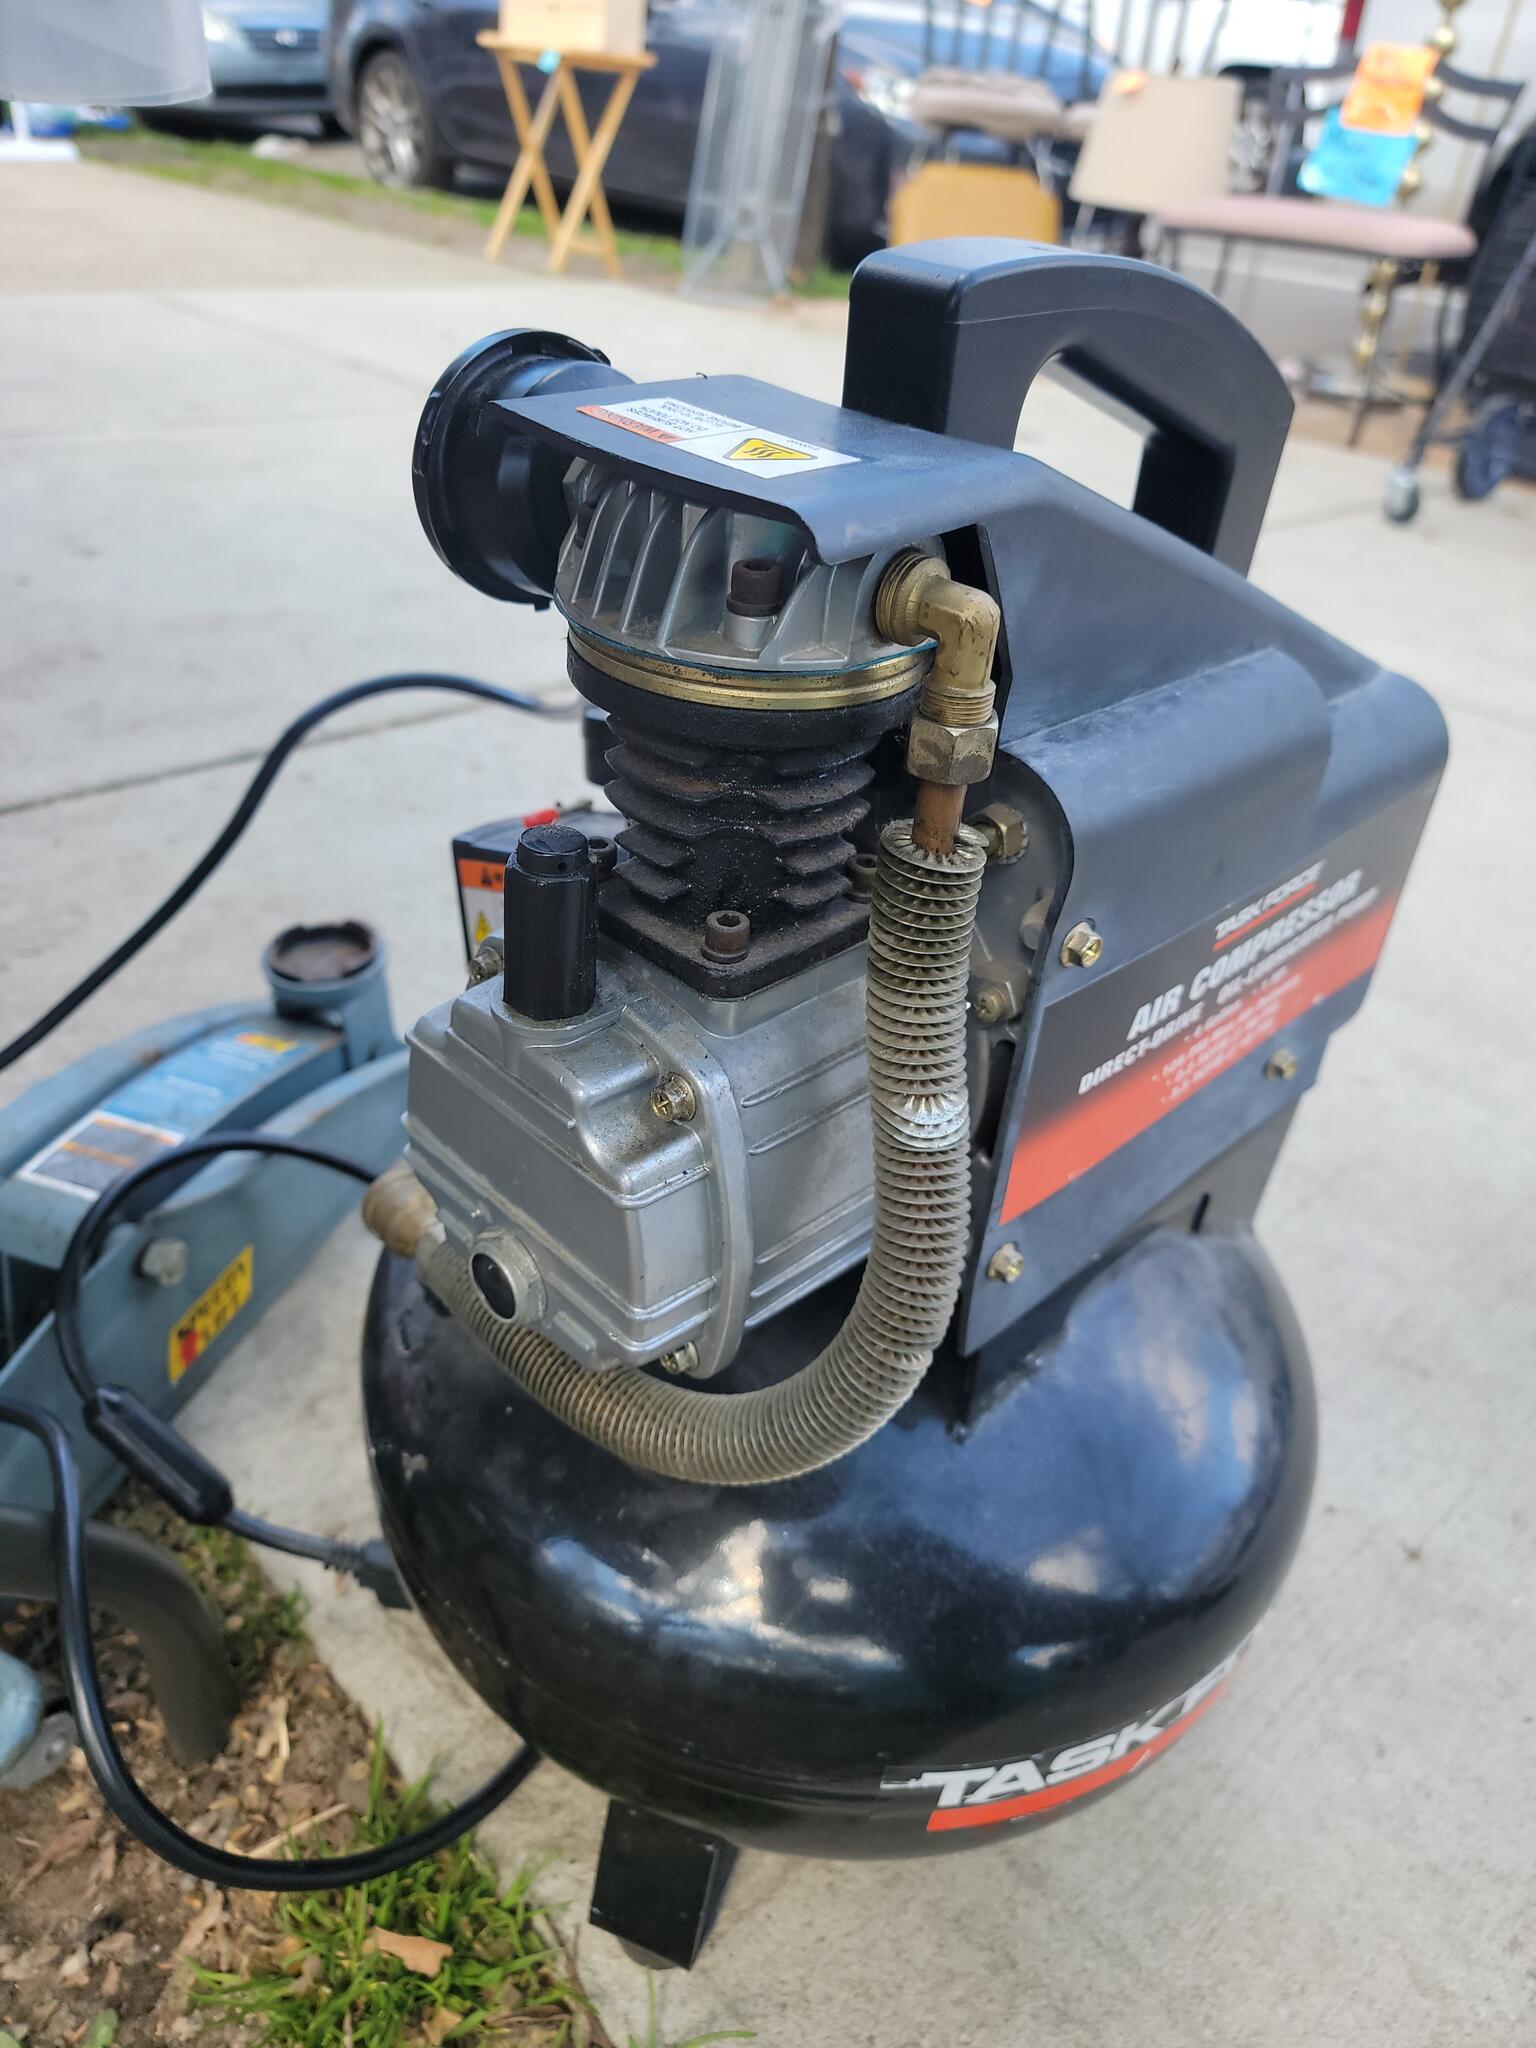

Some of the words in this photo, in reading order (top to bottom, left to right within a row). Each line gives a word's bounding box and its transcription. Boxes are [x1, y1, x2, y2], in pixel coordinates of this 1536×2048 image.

[1126, 984, 1185, 1041] AIR
[1189, 868, 1363, 1000] COMPRESSOR
[1078, 1000, 1205, 1095] DIRECT-DRIVE
[921, 1704, 1172, 1809] TASK
